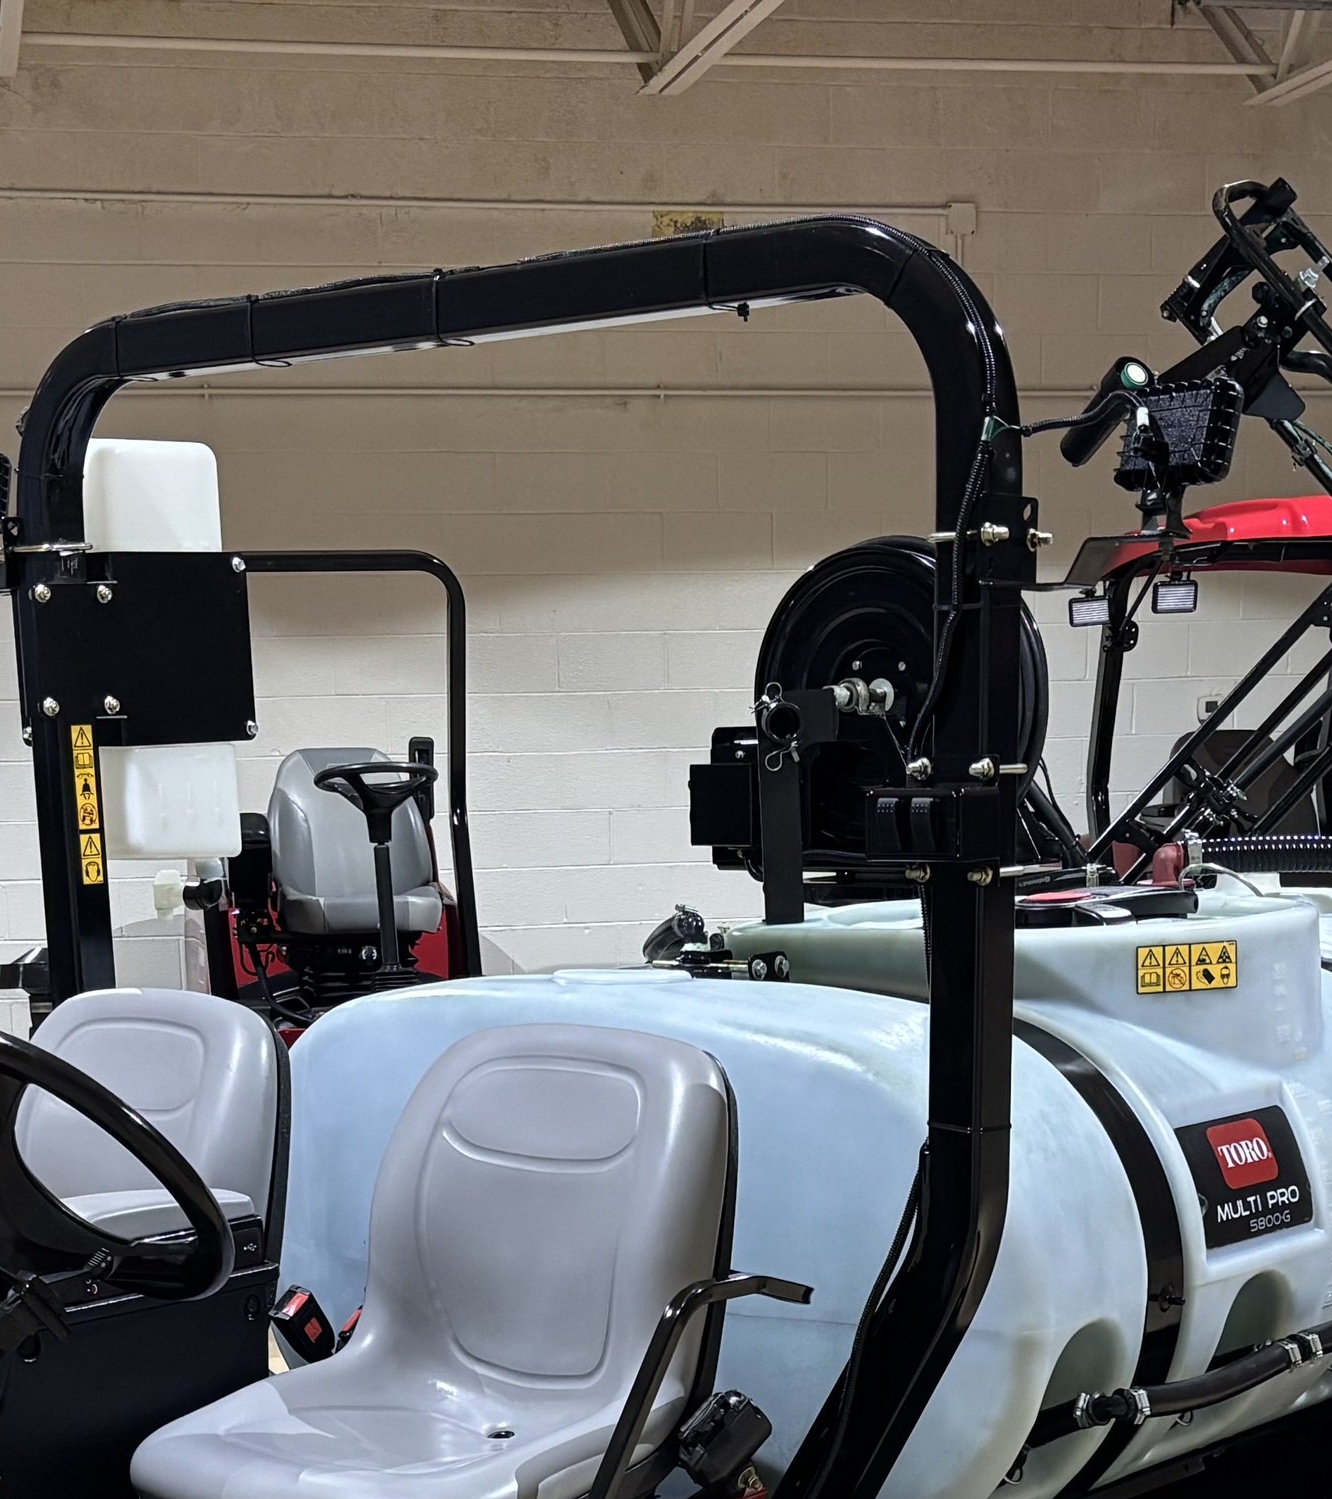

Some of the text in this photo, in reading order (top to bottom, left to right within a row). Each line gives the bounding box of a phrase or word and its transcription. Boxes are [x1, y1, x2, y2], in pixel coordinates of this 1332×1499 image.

[1217, 1137, 1269, 1168] TORO
[1217, 1185, 1300, 1223] MULTI PRO
